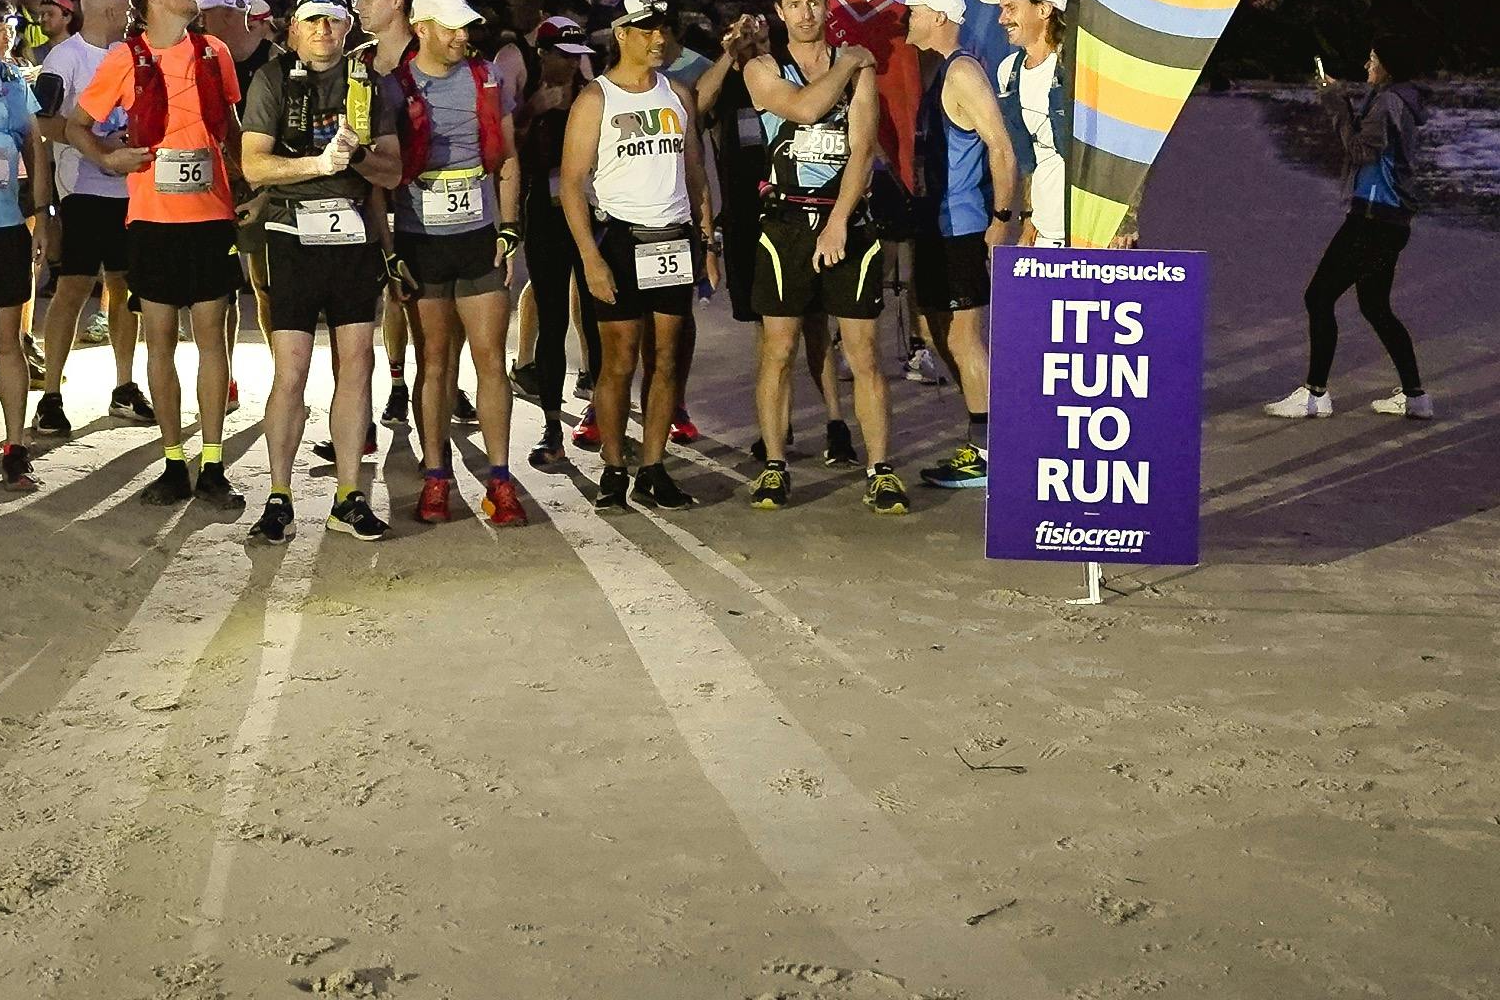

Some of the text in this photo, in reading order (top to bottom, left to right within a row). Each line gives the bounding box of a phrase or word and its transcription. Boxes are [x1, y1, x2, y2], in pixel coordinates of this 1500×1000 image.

[611, 107, 684, 142] RUN
[616, 140, 654, 158] PORT
[811, 133, 846, 155] 205
[179, 163, 202, 182] 56
[447, 192, 470, 212] 34
[328, 213, 341, 233] 2
[657, 255, 679, 275] 35
[1013, 257, 1186, 284] #hurtingsucks
[1051, 299, 1144, 345] IT'S
[1042, 352, 1149, 398] FUN
[1057, 406, 1131, 451] TO
[1037, 457, 1149, 504] RUN
[1036, 520, 1144, 547] fisiocrem
